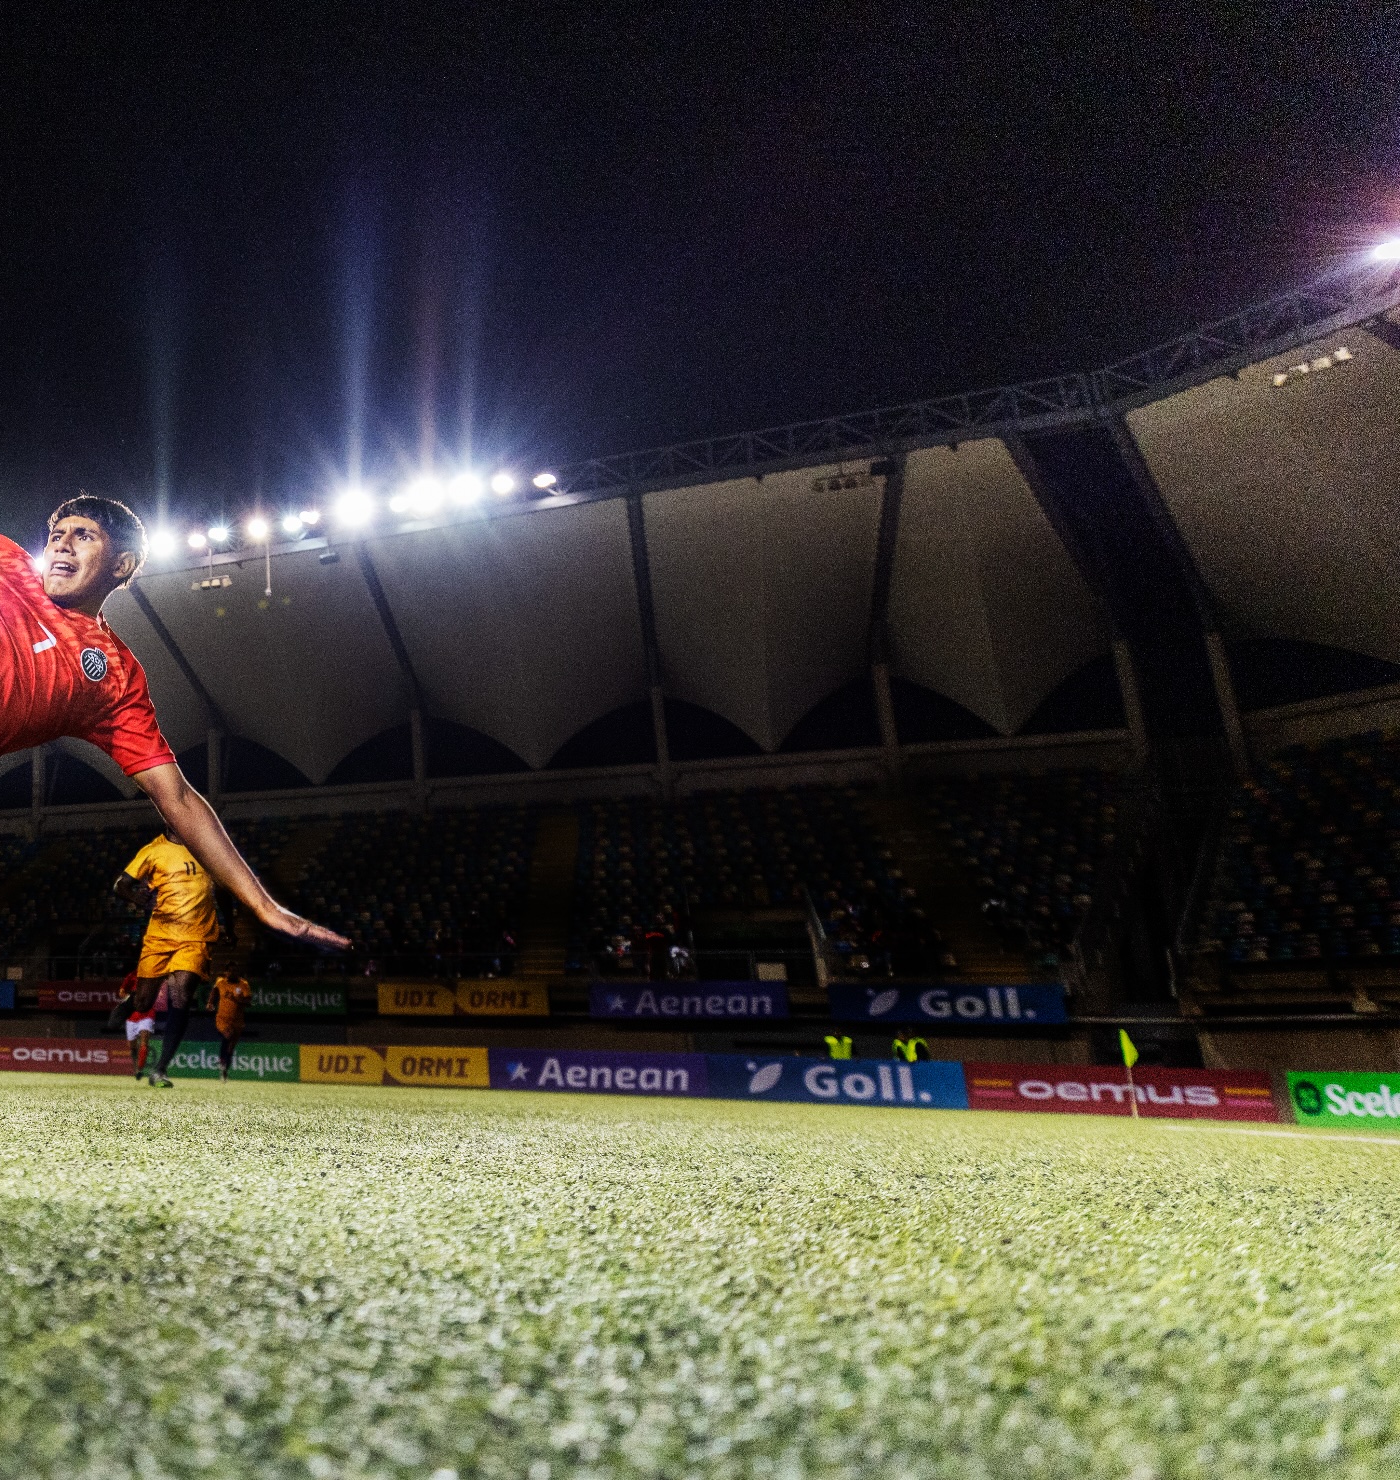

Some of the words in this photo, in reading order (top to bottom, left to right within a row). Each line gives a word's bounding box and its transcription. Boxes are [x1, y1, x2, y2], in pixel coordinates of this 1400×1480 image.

[184, 861, 197, 876] 11
[394, 991, 438, 1008] UDI
[469, 990, 532, 1009] ORMI
[635, 990, 773, 1015] Aenean
[919, 986, 1037, 1020] Goll.
[12, 1047, 109, 1063] oemus
[168, 1048, 293, 1078] celeisque
[317, 1055, 365, 1075] UDI
[401, 1056, 470, 1079] ORMI
[538, 1056, 689, 1091] Aenean
[803, 1063, 933, 1102] Goll.
[1018, 1080, 1220, 1106] oemus
